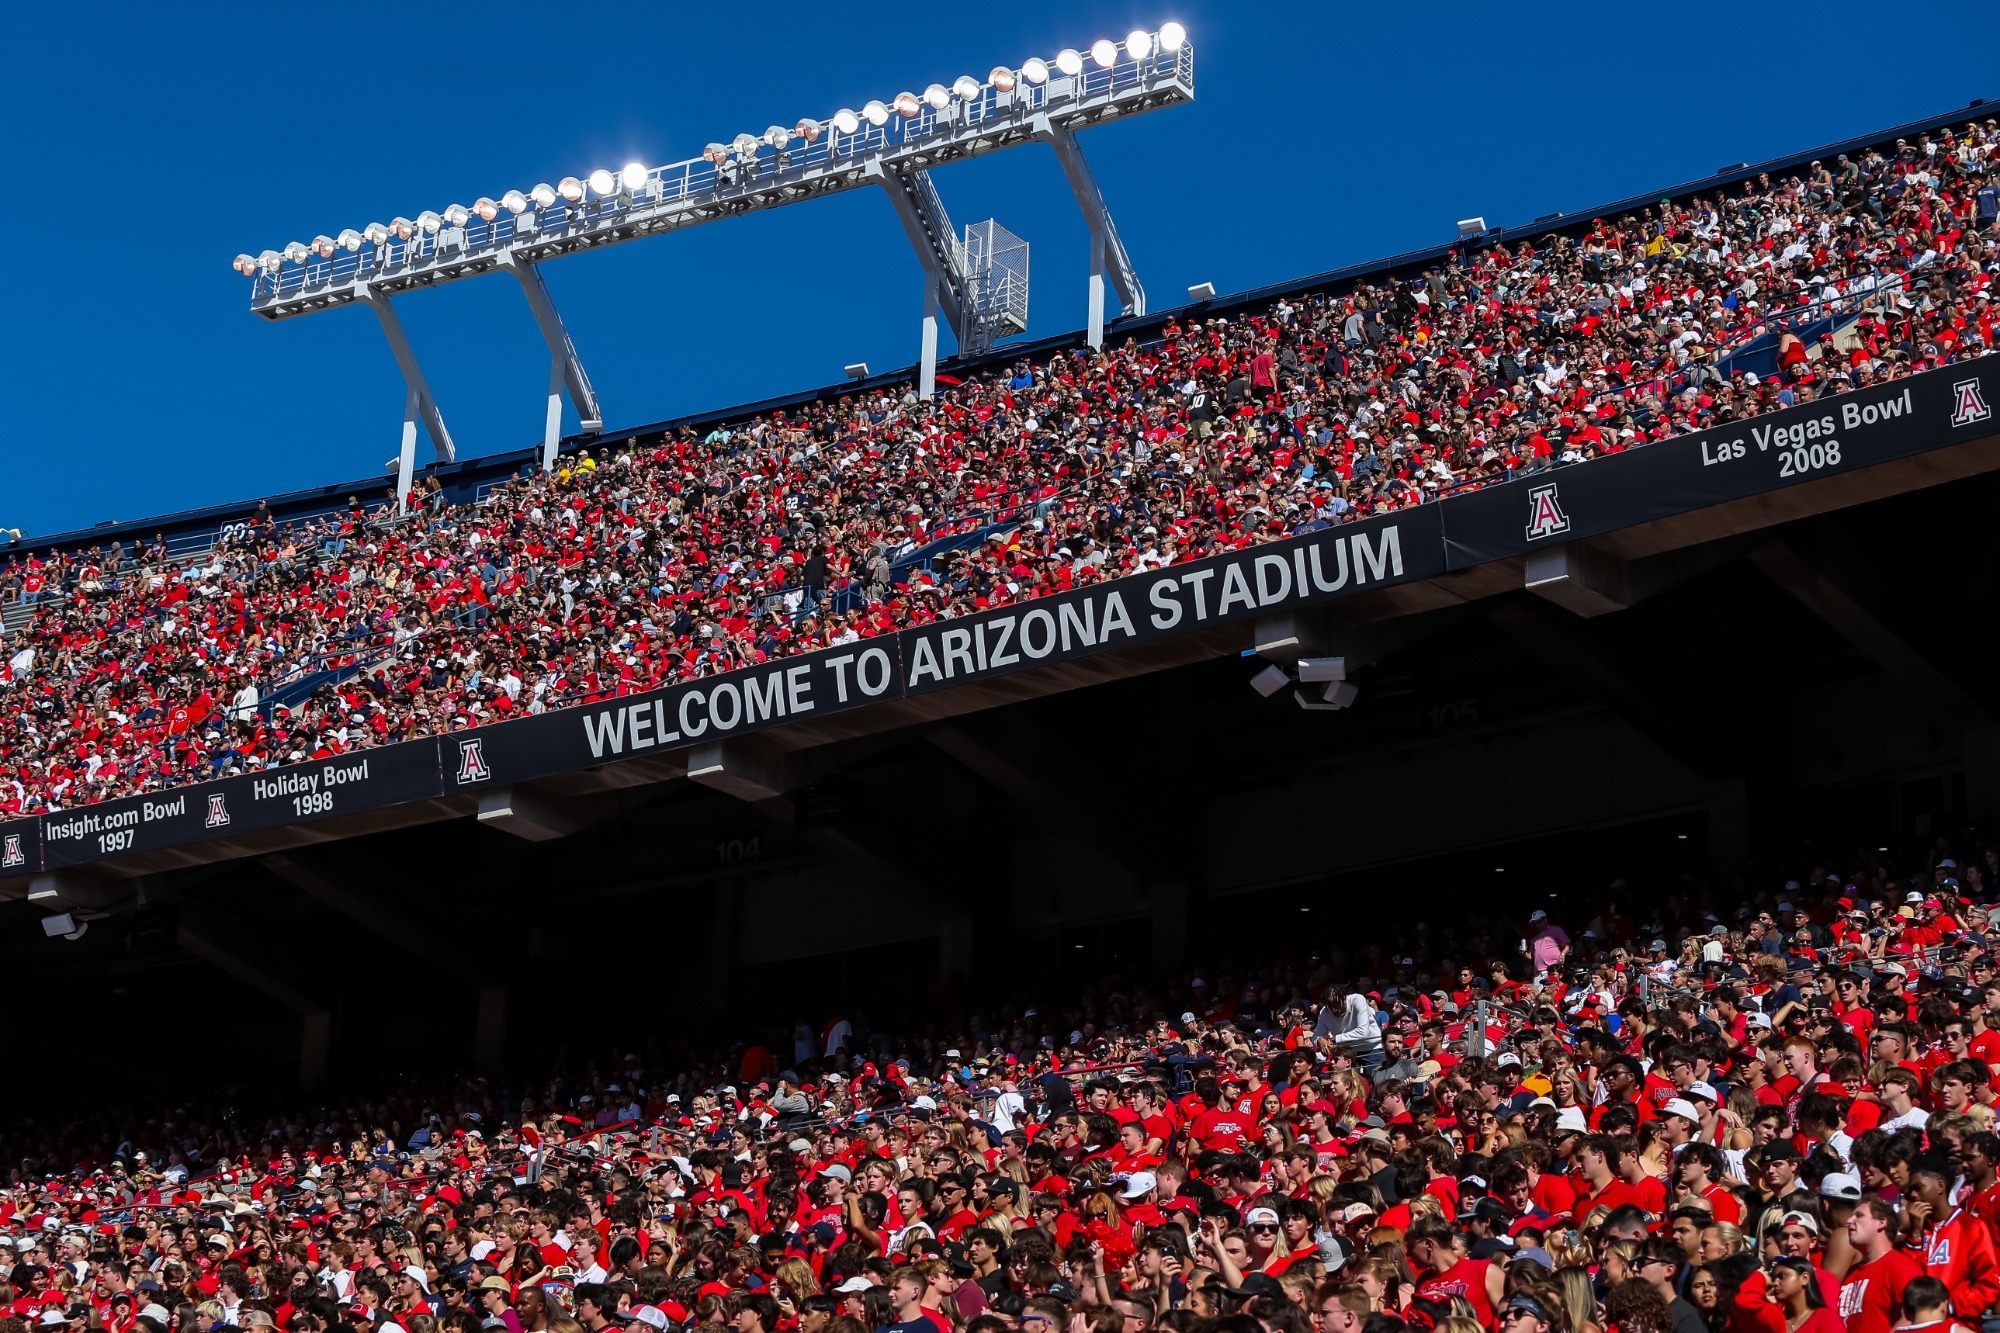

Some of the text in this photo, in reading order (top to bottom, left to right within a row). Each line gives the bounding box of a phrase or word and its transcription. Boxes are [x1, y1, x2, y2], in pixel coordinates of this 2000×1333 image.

[1950, 377, 1991, 428] A
[1701, 388, 1913, 467] Las Vegas Bowl
[1779, 440, 1842, 478] 2008
[1525, 482, 1570, 541] A
[583, 525, 1404, 758] WELCOME TO ARIZONA STADIUM
[254, 759, 369, 800] Holiday Bowl
[456, 738, 490, 785] A
[47, 795, 186, 841] Insight.com Bowl
[205, 793, 230, 828] A
[292, 791, 334, 817] 1998
[2, 834, 25, 868] A
[98, 829, 135, 854] 1997
[715, 836, 762, 866] 104
